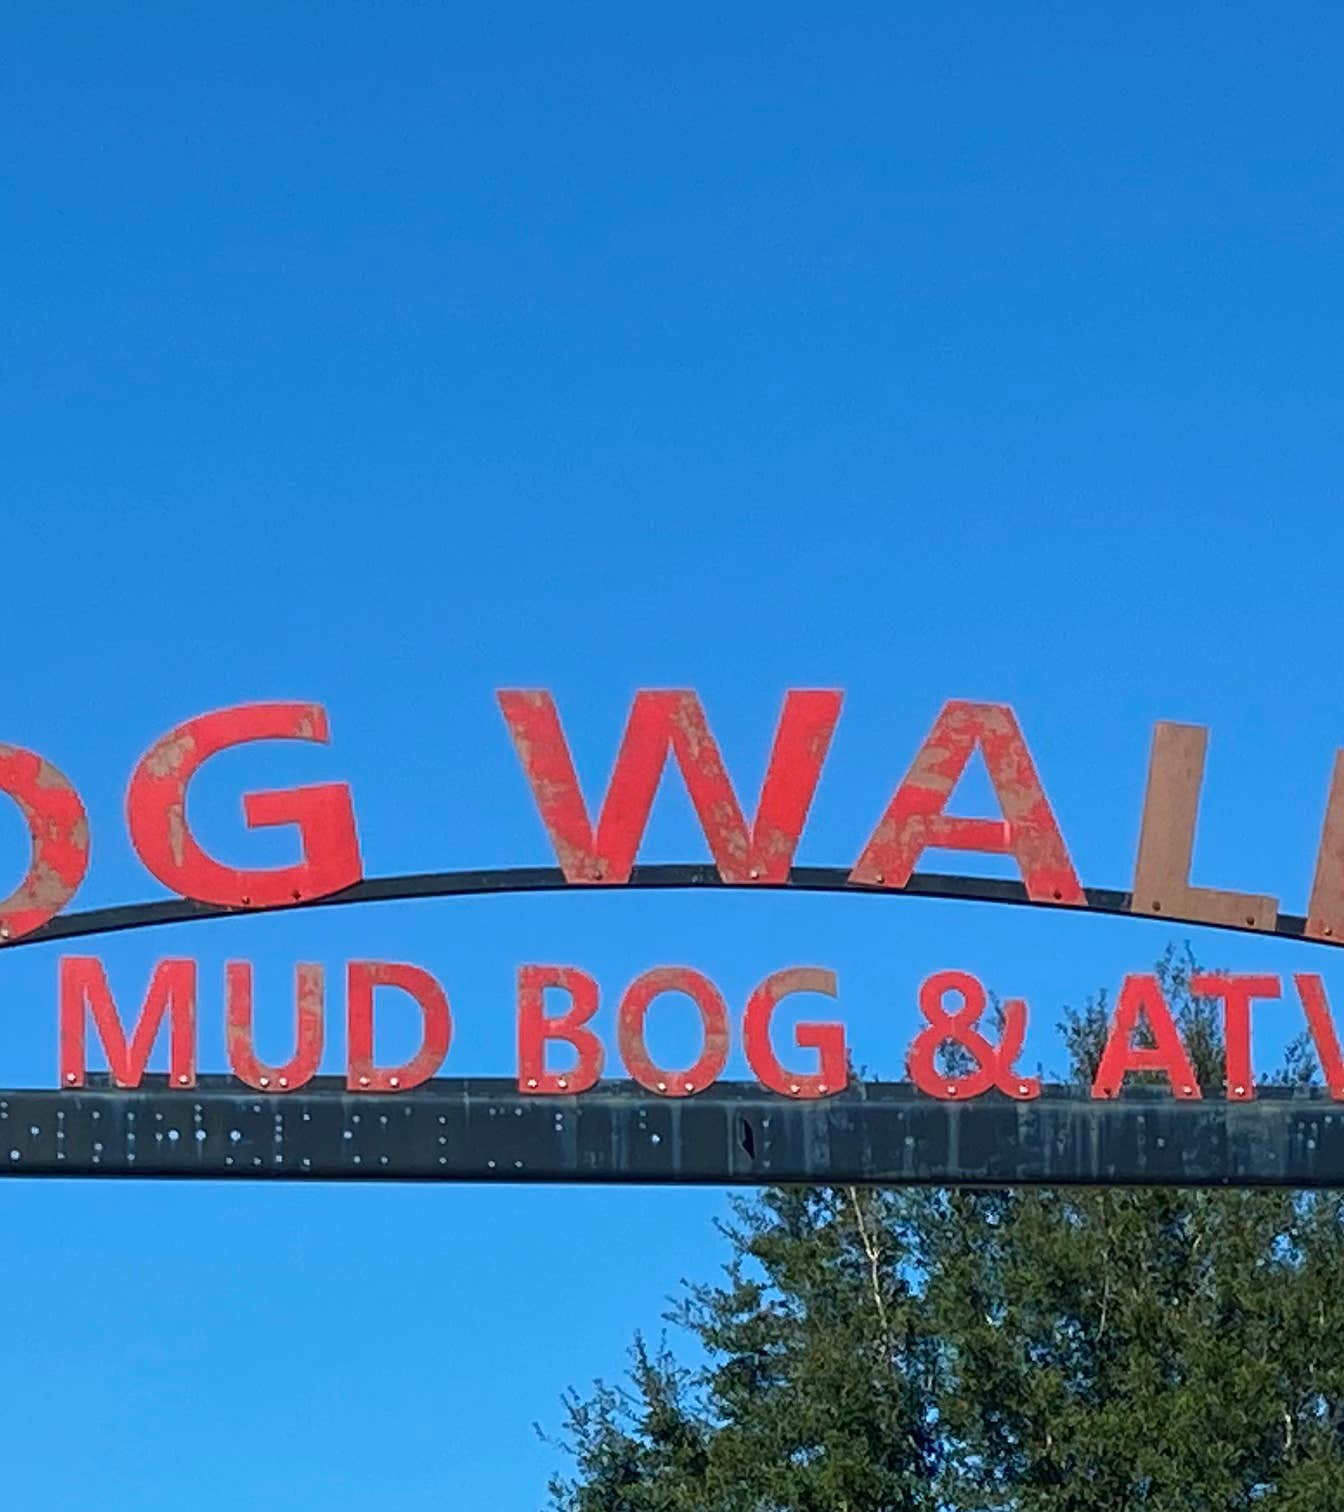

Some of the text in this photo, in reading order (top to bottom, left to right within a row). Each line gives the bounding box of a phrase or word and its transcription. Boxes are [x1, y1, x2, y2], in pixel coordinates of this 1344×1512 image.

[60, 955, 452, 1092] MUD
[516, 964, 849, 1099] BOG
[907, 970, 1042, 1101] &
